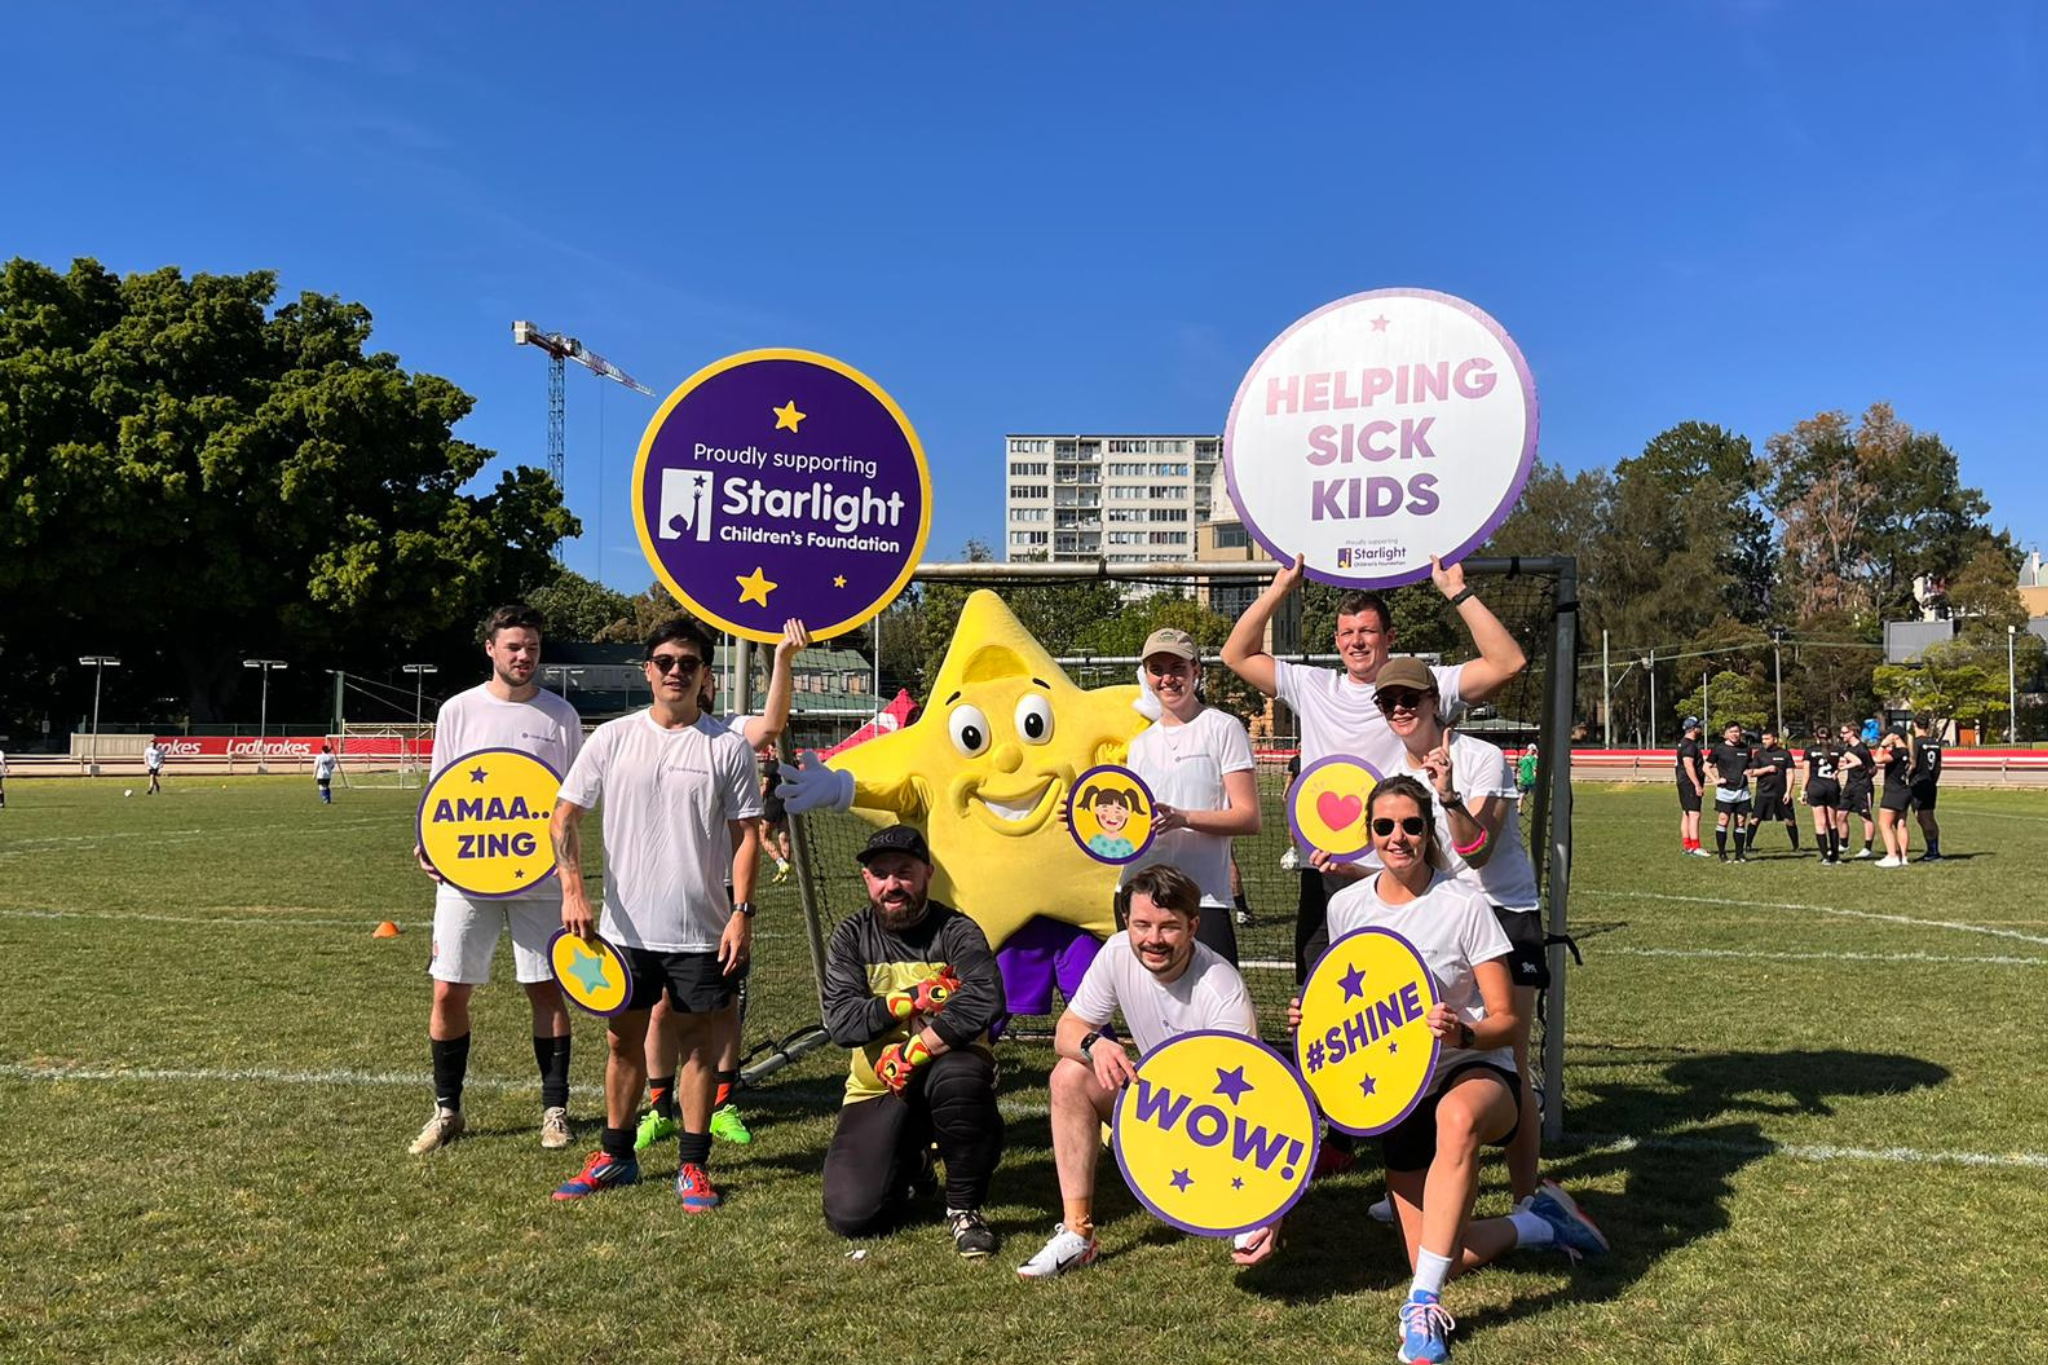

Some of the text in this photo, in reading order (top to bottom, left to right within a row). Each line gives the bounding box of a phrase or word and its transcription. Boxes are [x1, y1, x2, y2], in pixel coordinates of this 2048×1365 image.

[1265, 357, 1498, 416] HELPING
[1305, 417, 1436, 466] SICK
[694, 443, 877, 479] Proudly supporting
[722, 477, 904, 533] Starlight
[1311, 473, 1440, 521] KIDS
[719, 525, 900, 553] Children's Foundation
[1354, 547, 1407, 561] Starlight
[155, 739, 202, 755] rokes
[226, 739, 311, 755] Ladbrokes
[1926, 750, 1936, 770] 9
[432, 796, 550, 823] AMAA..
[457, 832, 536, 859] ZING
[1306, 981, 1424, 1074] #SHINE
[1136, 1078, 1304, 1180] WOW!
